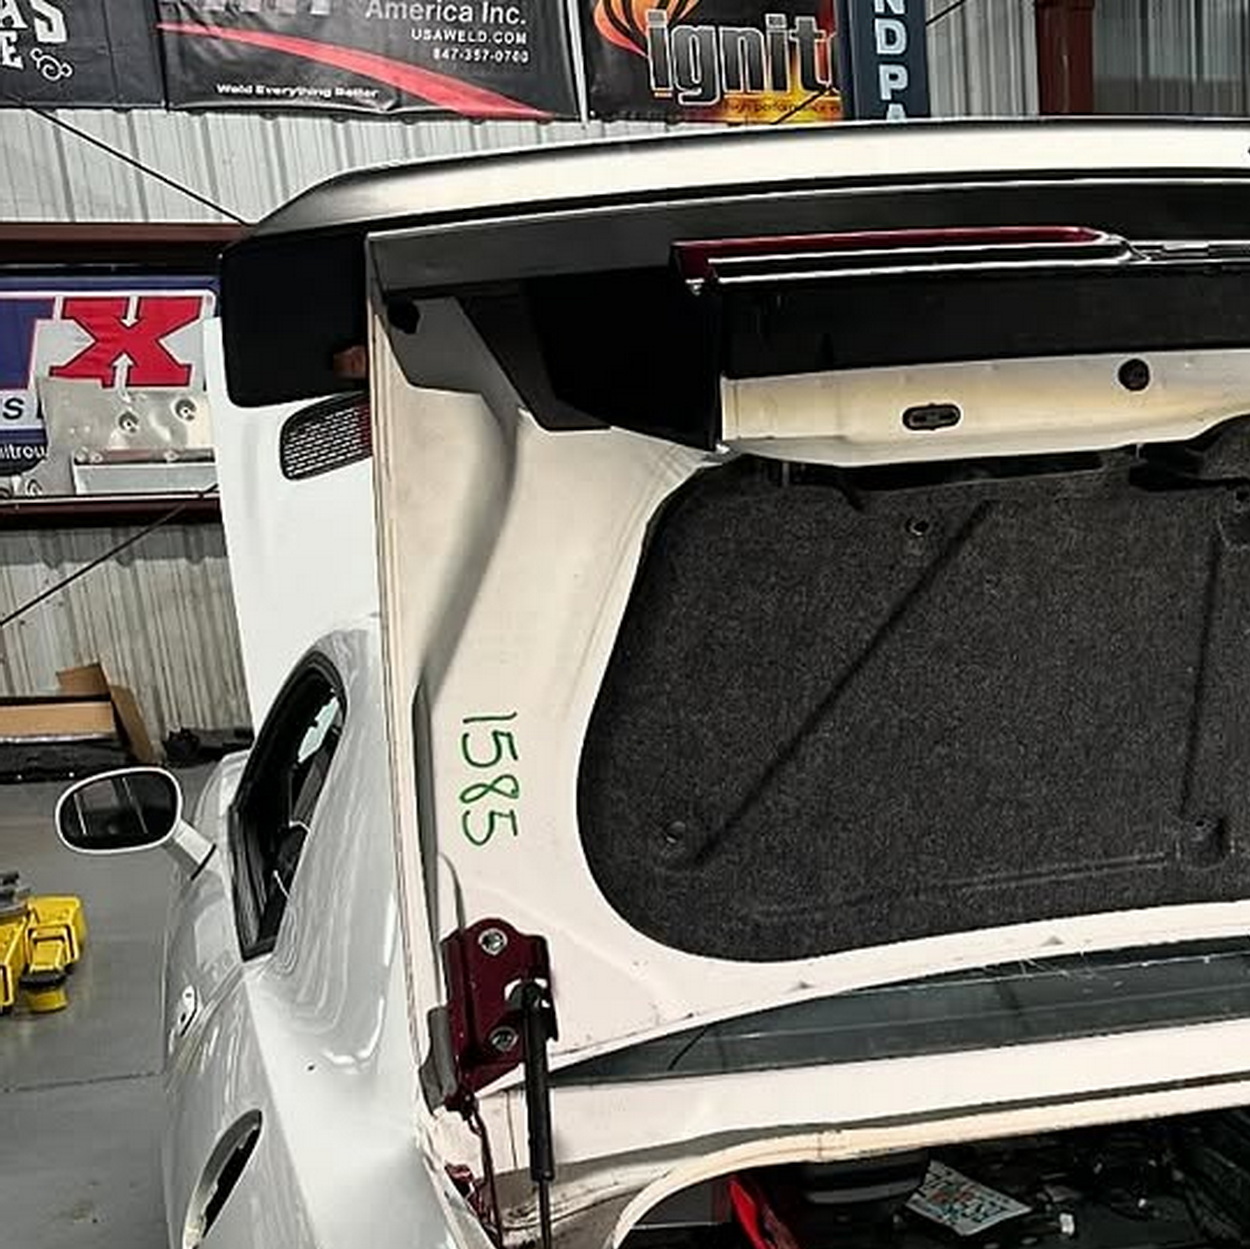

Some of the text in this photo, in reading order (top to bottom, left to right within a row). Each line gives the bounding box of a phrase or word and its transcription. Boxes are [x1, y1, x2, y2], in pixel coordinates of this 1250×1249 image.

[365, 0, 527, 25] America Inc.
[411, 28, 527, 44] USAWELD.COM
[646, 9, 840, 105] ignit
[0, 443, 48, 460] itrou
[459, 711, 519, 846] 1585
